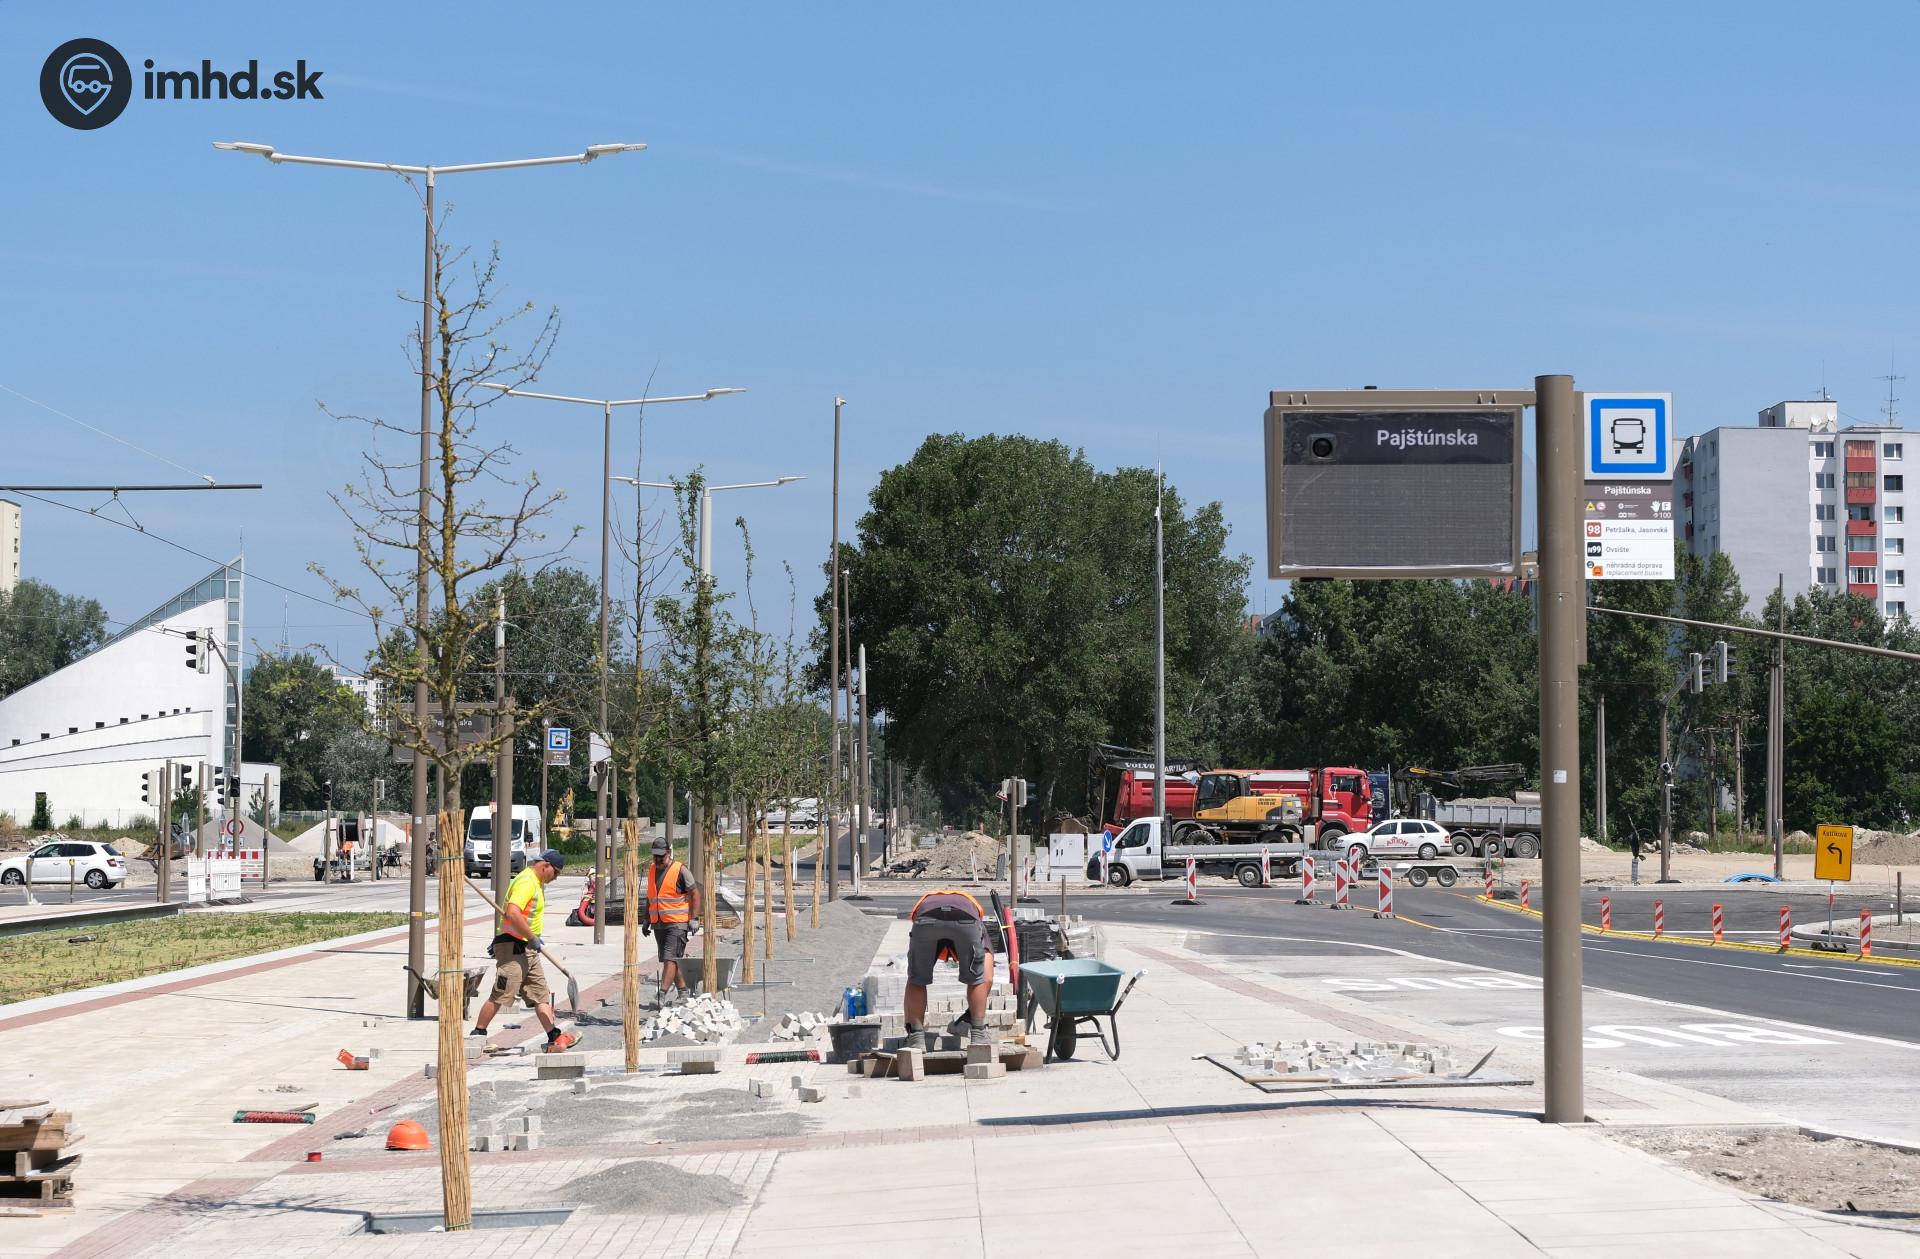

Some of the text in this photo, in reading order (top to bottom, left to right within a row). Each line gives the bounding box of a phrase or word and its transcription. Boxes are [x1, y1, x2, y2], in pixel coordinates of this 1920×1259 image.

[1376, 428, 1479, 450] Pajštúnska
[1604, 486, 1651, 496] Pajštúnska
[1587, 525, 1601, 535] 98
[1124, 762, 1155, 770] VOLVO
[1321, 977, 1543, 992] BUS
[1495, 1023, 1844, 1049] BUS
